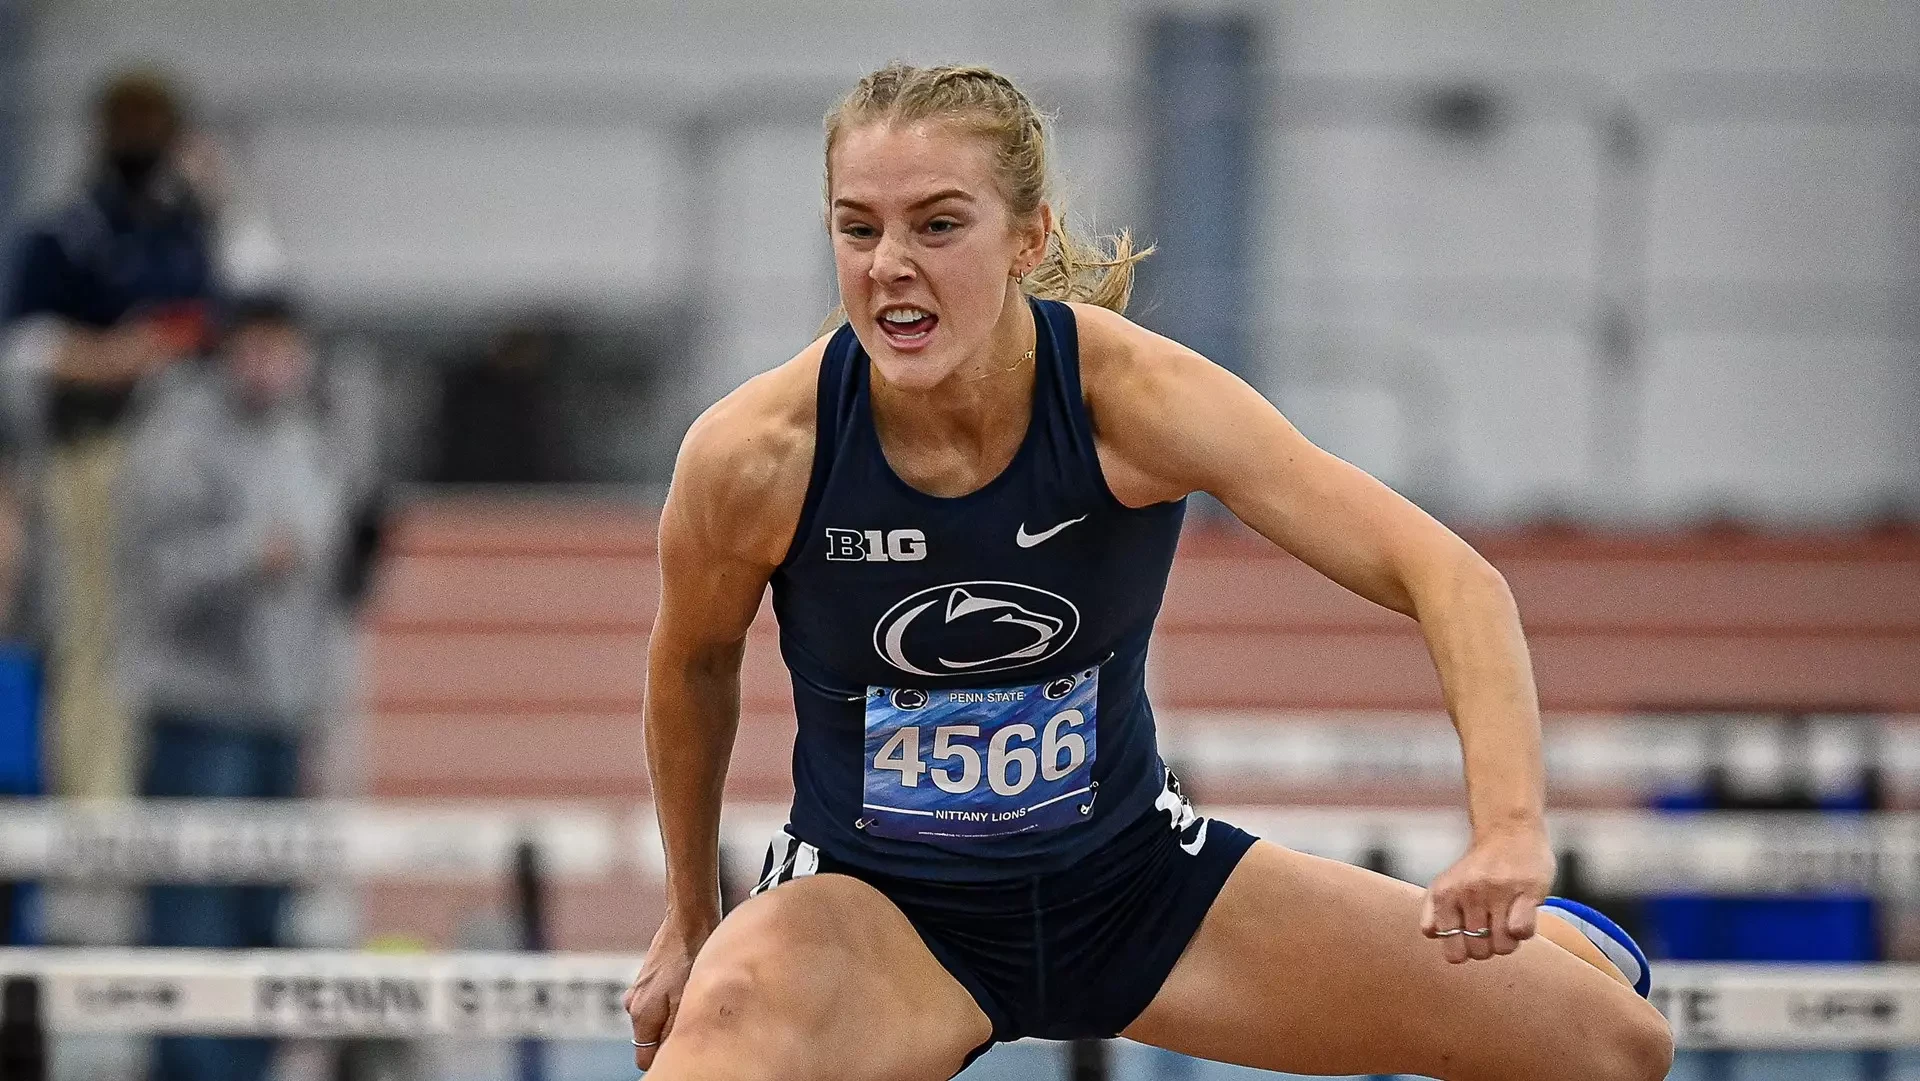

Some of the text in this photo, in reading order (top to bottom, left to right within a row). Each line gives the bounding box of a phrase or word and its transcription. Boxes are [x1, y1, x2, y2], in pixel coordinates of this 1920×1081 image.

[949, 691, 1025, 703] PENN STATE
[873, 709, 1086, 796] 4566
[935, 807, 1026, 822] NITTANY LIONS
